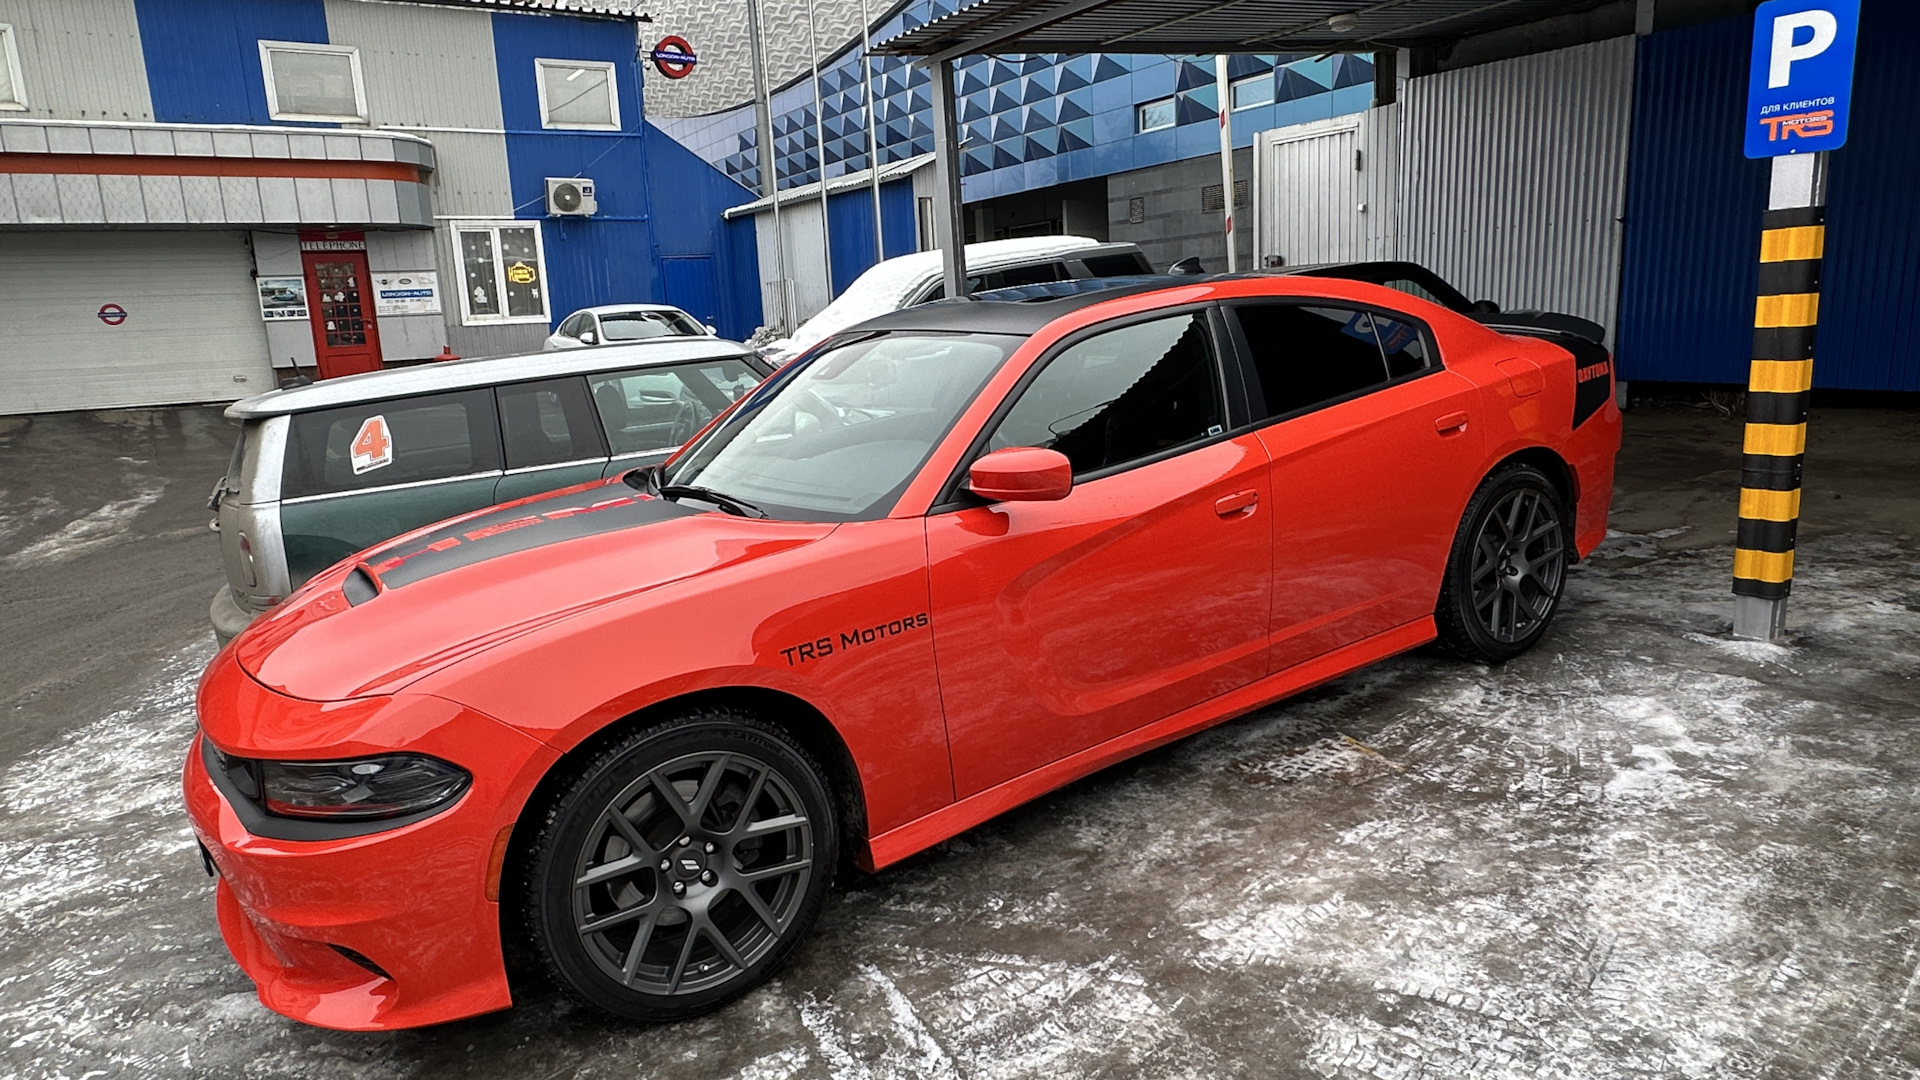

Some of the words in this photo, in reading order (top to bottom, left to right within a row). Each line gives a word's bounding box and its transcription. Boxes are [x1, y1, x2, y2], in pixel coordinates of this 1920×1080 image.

[1767, 9, 1838, 89] P
[1760, 104, 1781, 115] ДЛЯ
[1782, 97, 1835, 111] КЛИЕНТОВ
[1760, 109, 1834, 141] TRS
[1782, 115, 1828, 126] MOTORS
[301, 241, 366, 250] TELEPHONE
[1578, 361, 1609, 382] DAYTONA
[353, 417, 389, 461] 4
[780, 637, 834, 666] TRS
